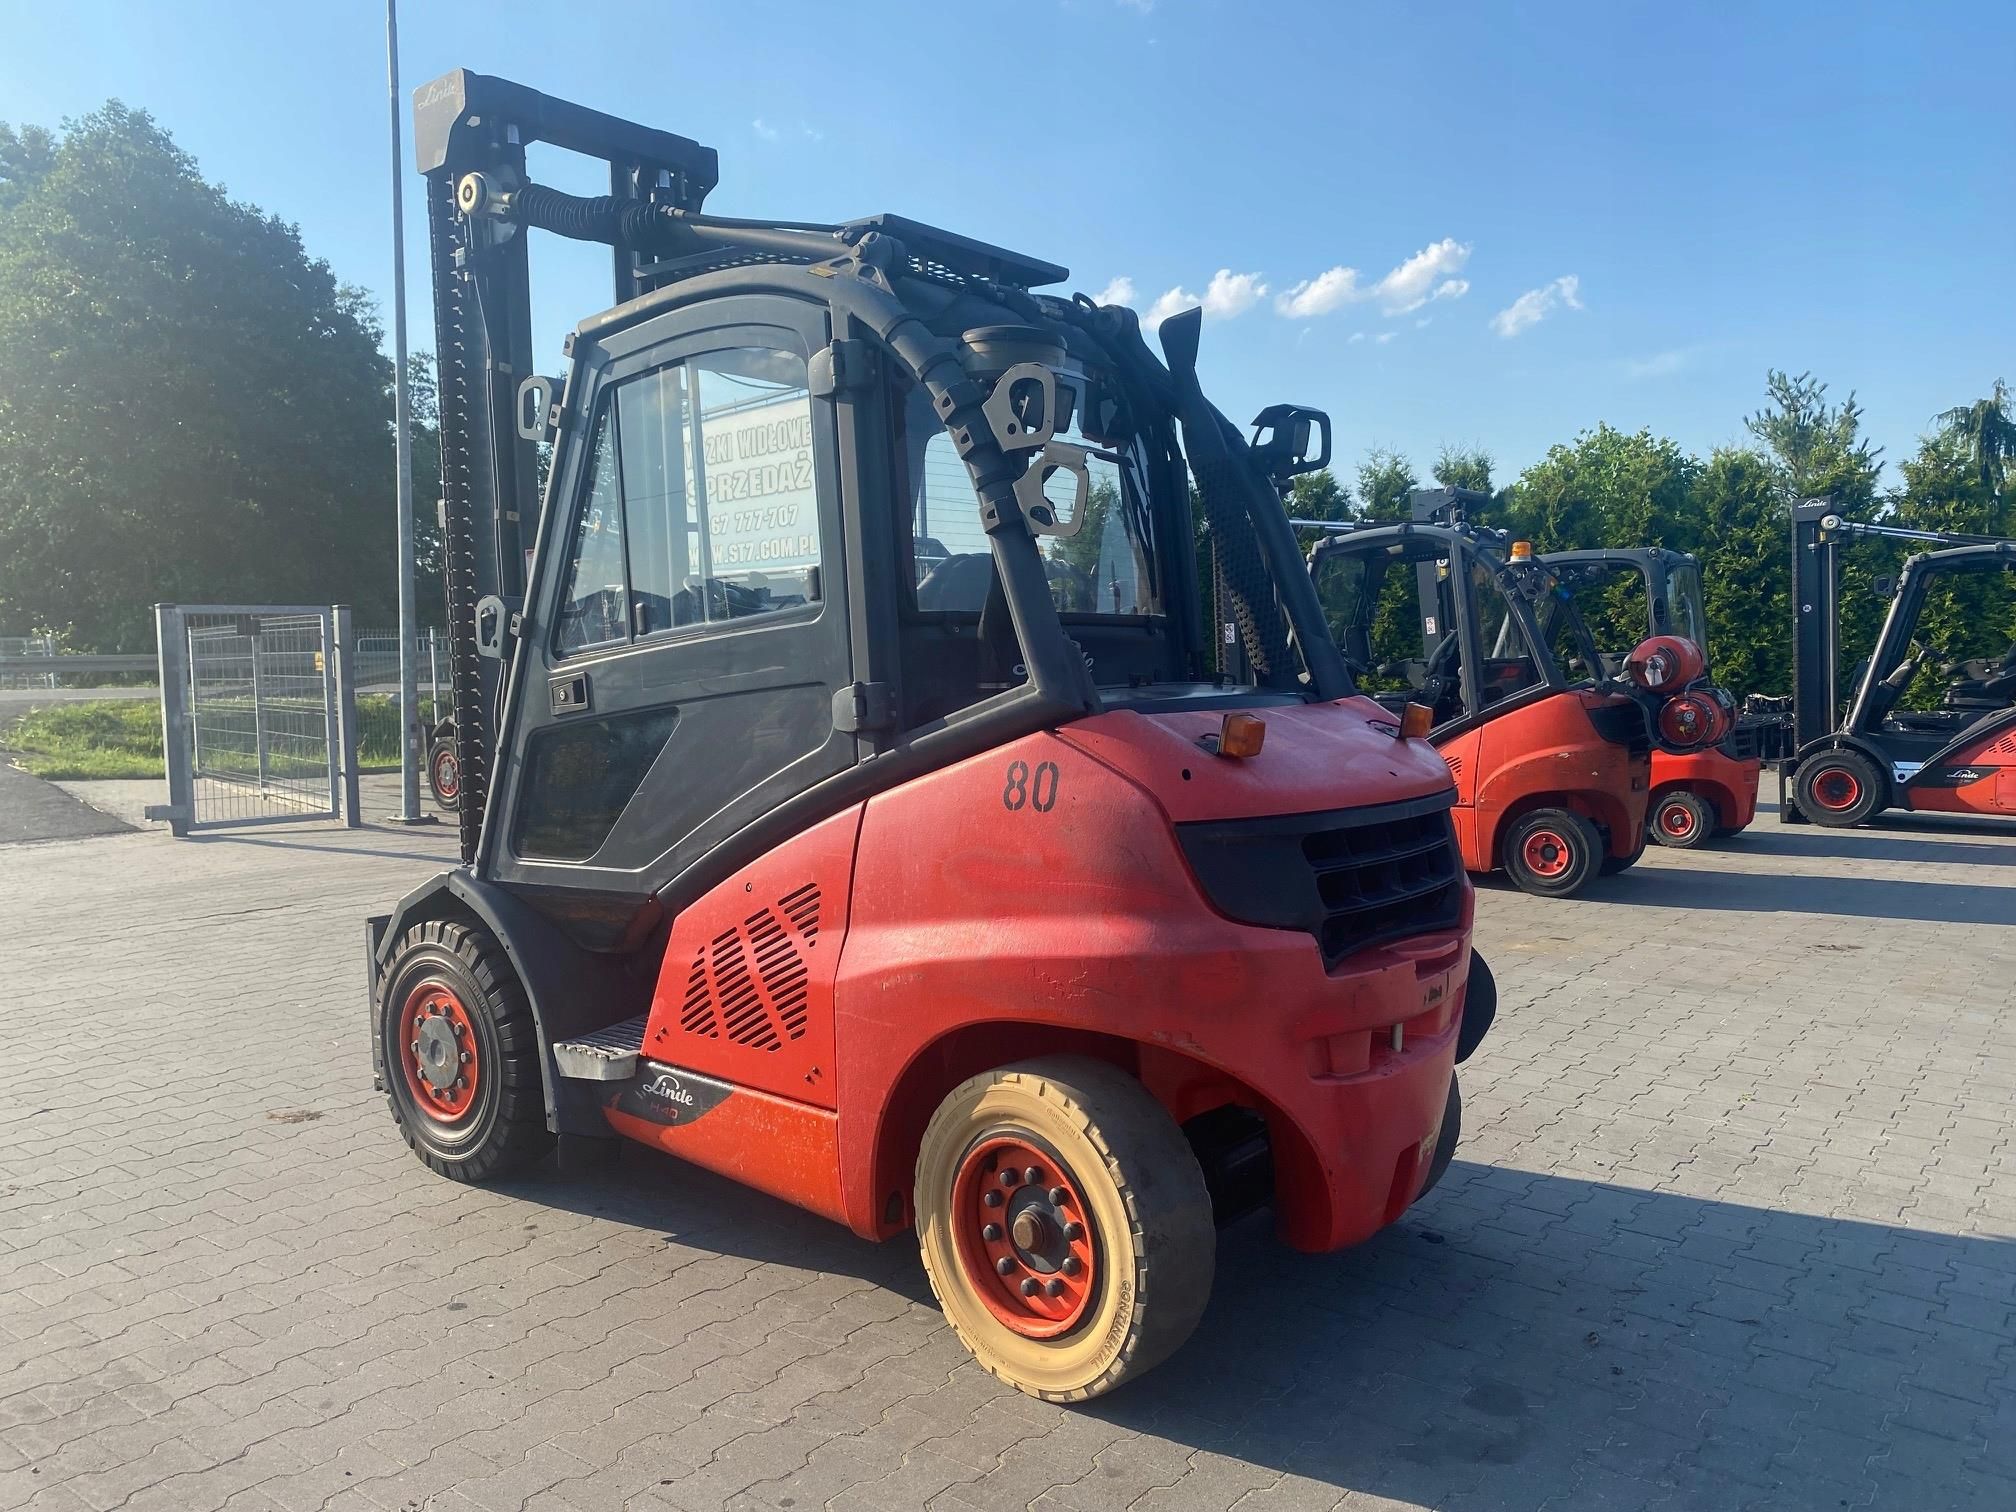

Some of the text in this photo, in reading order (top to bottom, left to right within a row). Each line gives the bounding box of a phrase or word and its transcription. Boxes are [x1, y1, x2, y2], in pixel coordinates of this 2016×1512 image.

[736, 415, 811, 460] WIDŁOWE
[710, 503, 799, 535] 67 777-707
[1797, 498, 1827, 509] Linde
[1003, 760, 1060, 813] 80
[1946, 769, 1979, 779] Linde
[642, 1074, 694, 1106] Linde
[1088, 1279, 1132, 1370] CONTINENTAL
